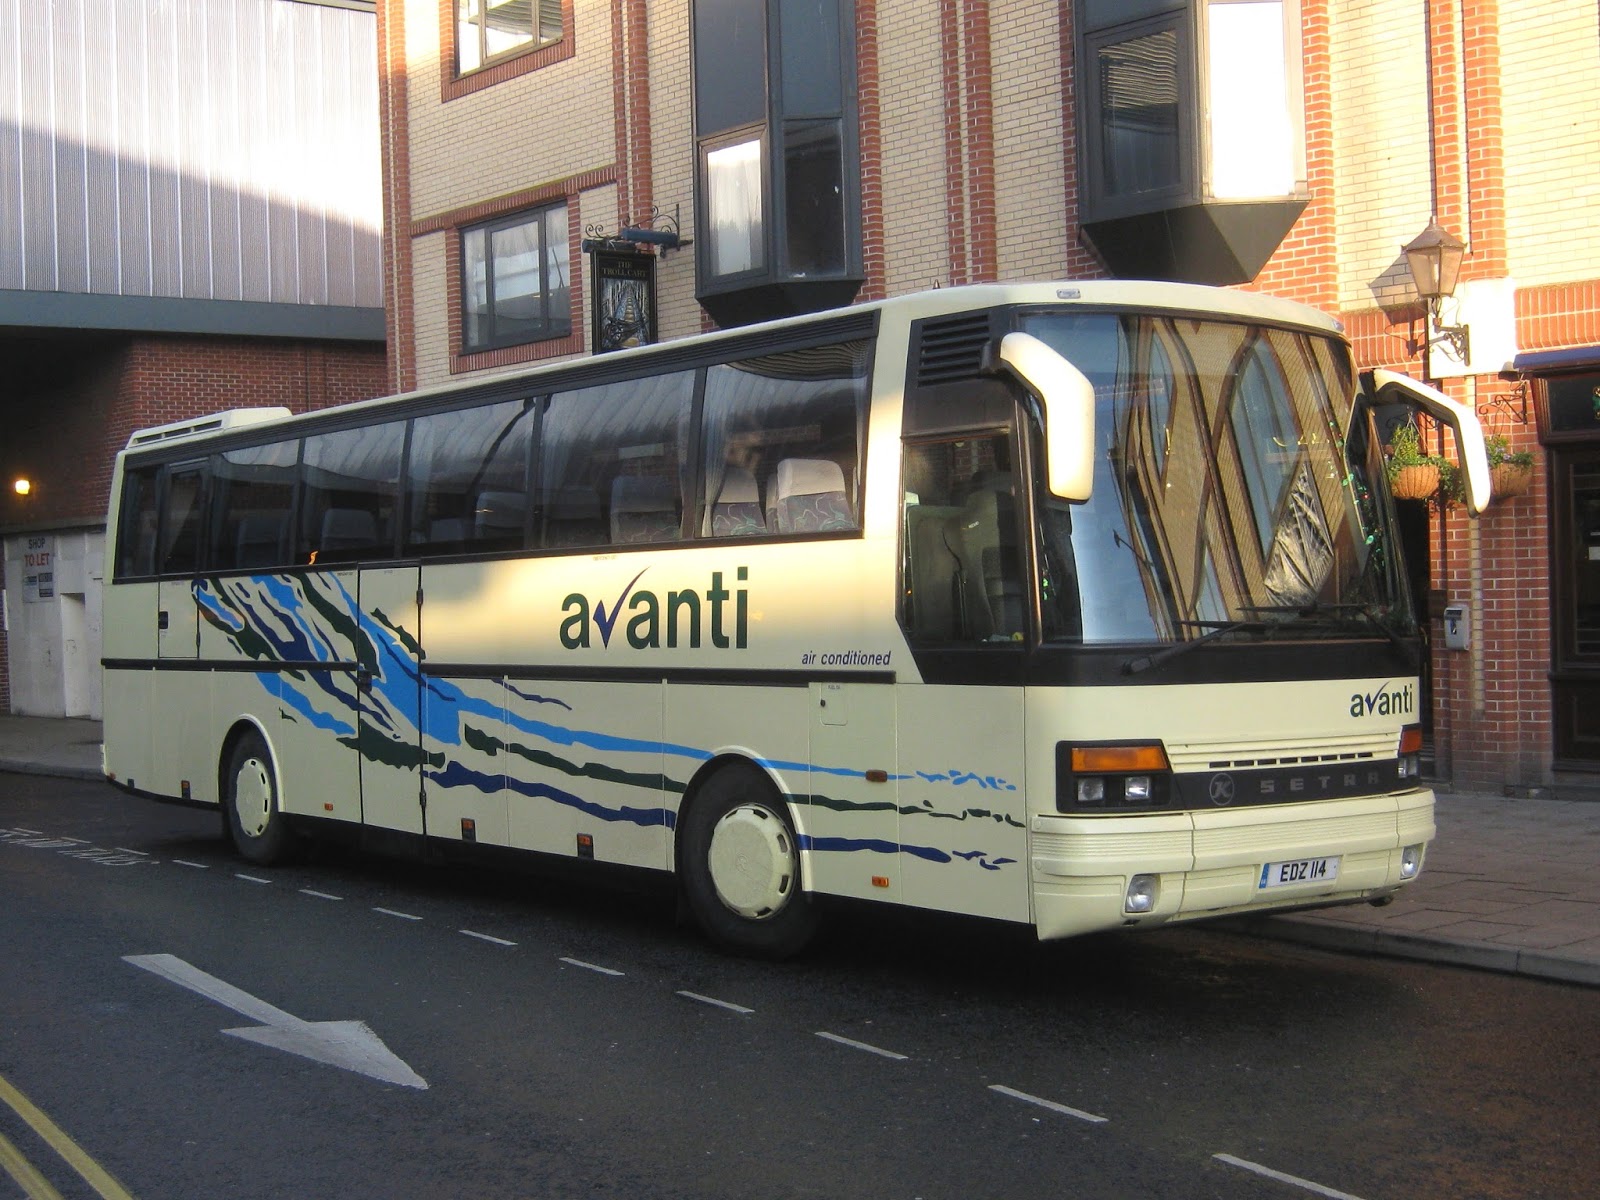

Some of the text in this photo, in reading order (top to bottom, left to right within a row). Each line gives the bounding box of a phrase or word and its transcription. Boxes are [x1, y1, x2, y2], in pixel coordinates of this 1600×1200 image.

[617, 261, 633, 269] THE
[28, 538, 46, 549] SHOP
[24, 553, 50, 567] TO LET
[559, 566, 748, 650] avanti
[801, 650, 891, 666] air conditioned
[1350, 681, 1412, 717] avanti
[1260, 772, 1380, 793] SETRA
[1280, 860, 1326, 882] EDZ 114
